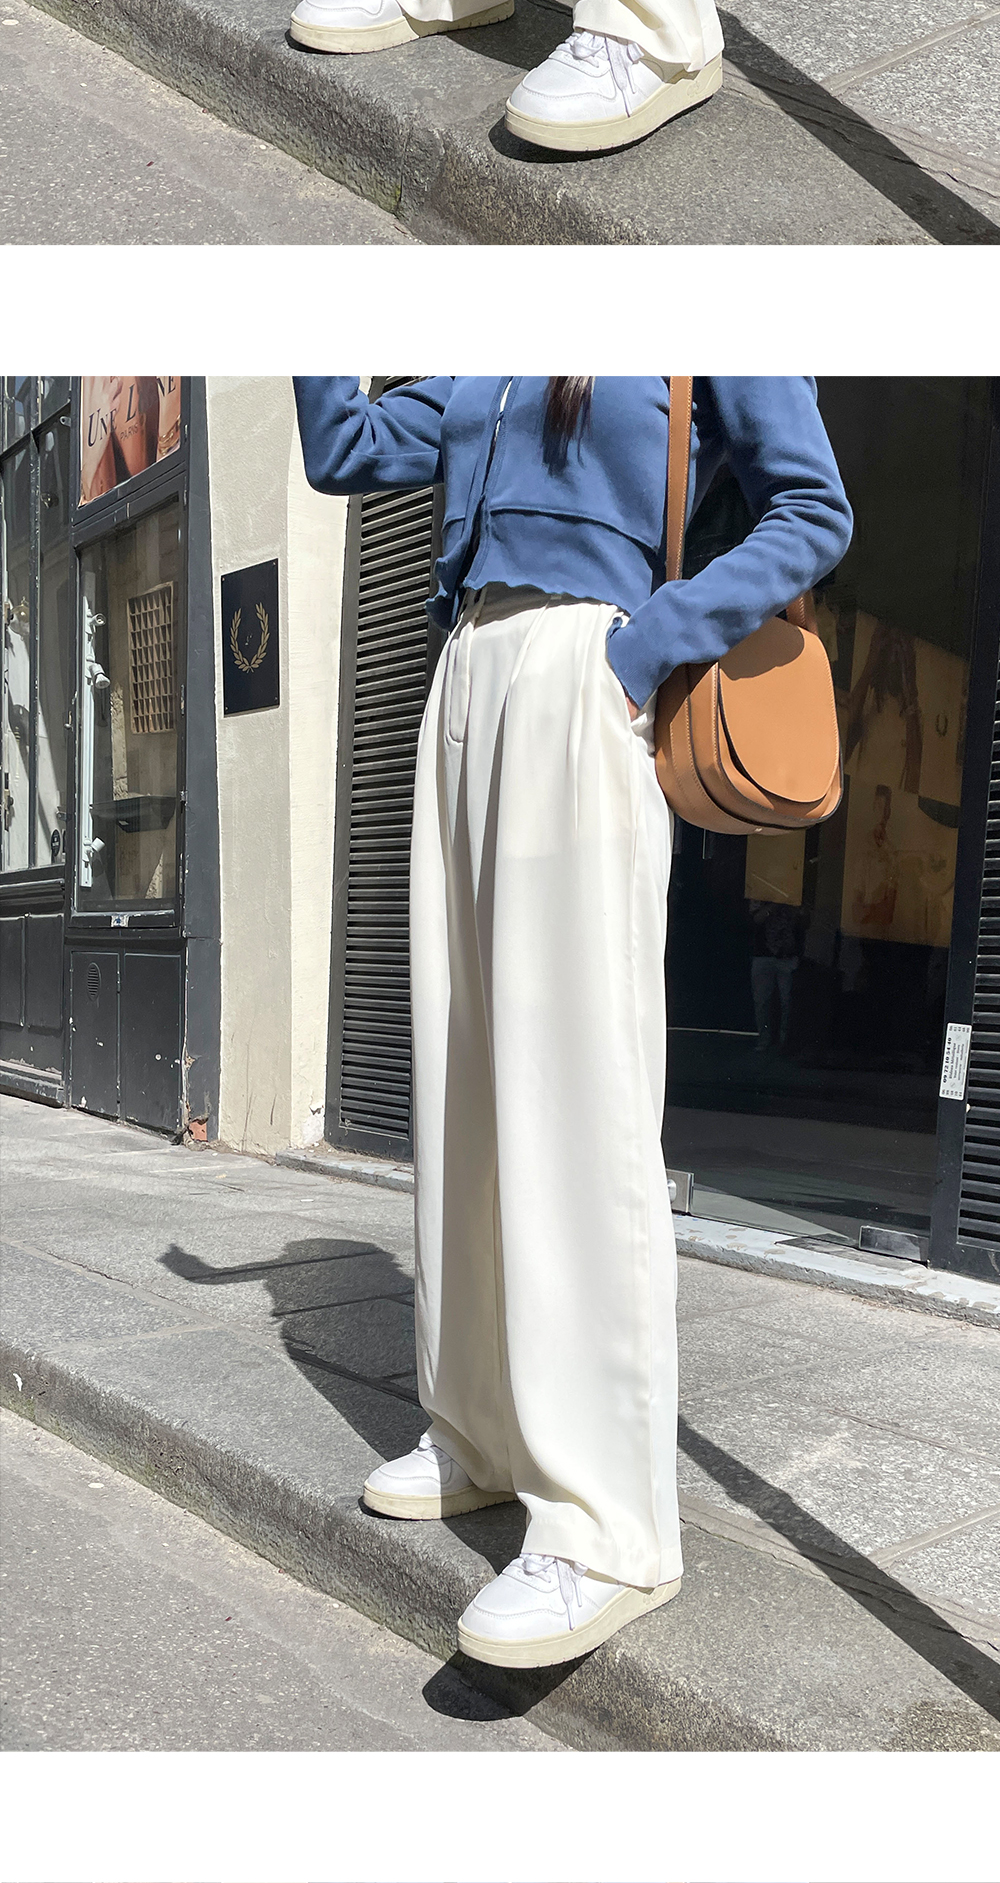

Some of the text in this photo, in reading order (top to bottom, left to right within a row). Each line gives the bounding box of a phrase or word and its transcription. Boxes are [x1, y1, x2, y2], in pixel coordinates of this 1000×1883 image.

[88, 408, 117, 447] UNE
[947, 1037, 952, 1045] 40
[945, 1056, 950, 1064] 10
[944, 1065, 949, 1073] 72
[943, 1074, 948, 1083] 09
